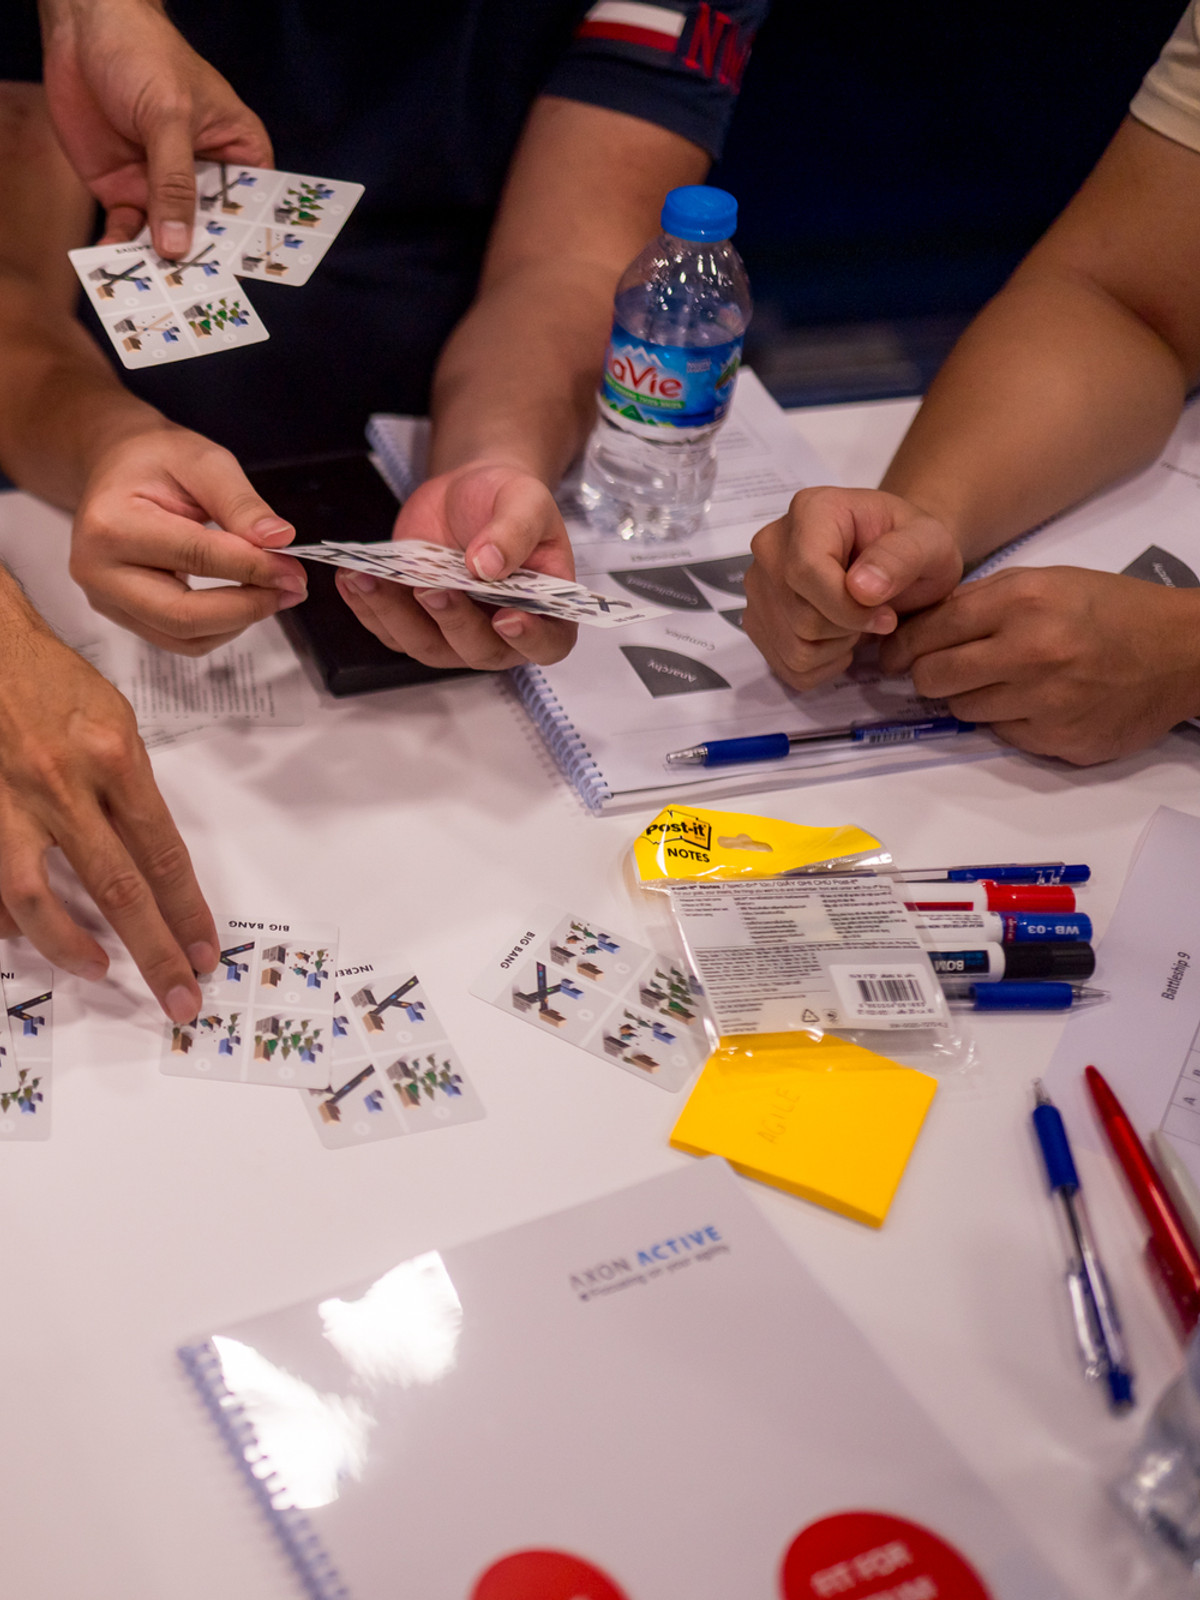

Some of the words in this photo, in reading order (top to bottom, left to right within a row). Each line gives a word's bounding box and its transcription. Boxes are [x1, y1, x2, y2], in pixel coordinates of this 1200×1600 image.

[665, 627, 716, 651] Complex
[648, 658, 698, 683] Anarchy
[667, 847, 711, 863] NOTES
[228, 920, 265, 931] BANG
[269, 923, 291, 932] BIG
[519, 931, 536, 946] BIG
[499, 945, 524, 970] BANG
[1161, 959, 1191, 1001] Battleship
[1177, 951, 1192, 961] 9
[757, 1087, 801, 1144] AGILE
[569, 1258, 633, 1291] AXON
[636, 1225, 722, 1267] ACTIVE
[853, 1538, 915, 1582] FOR
